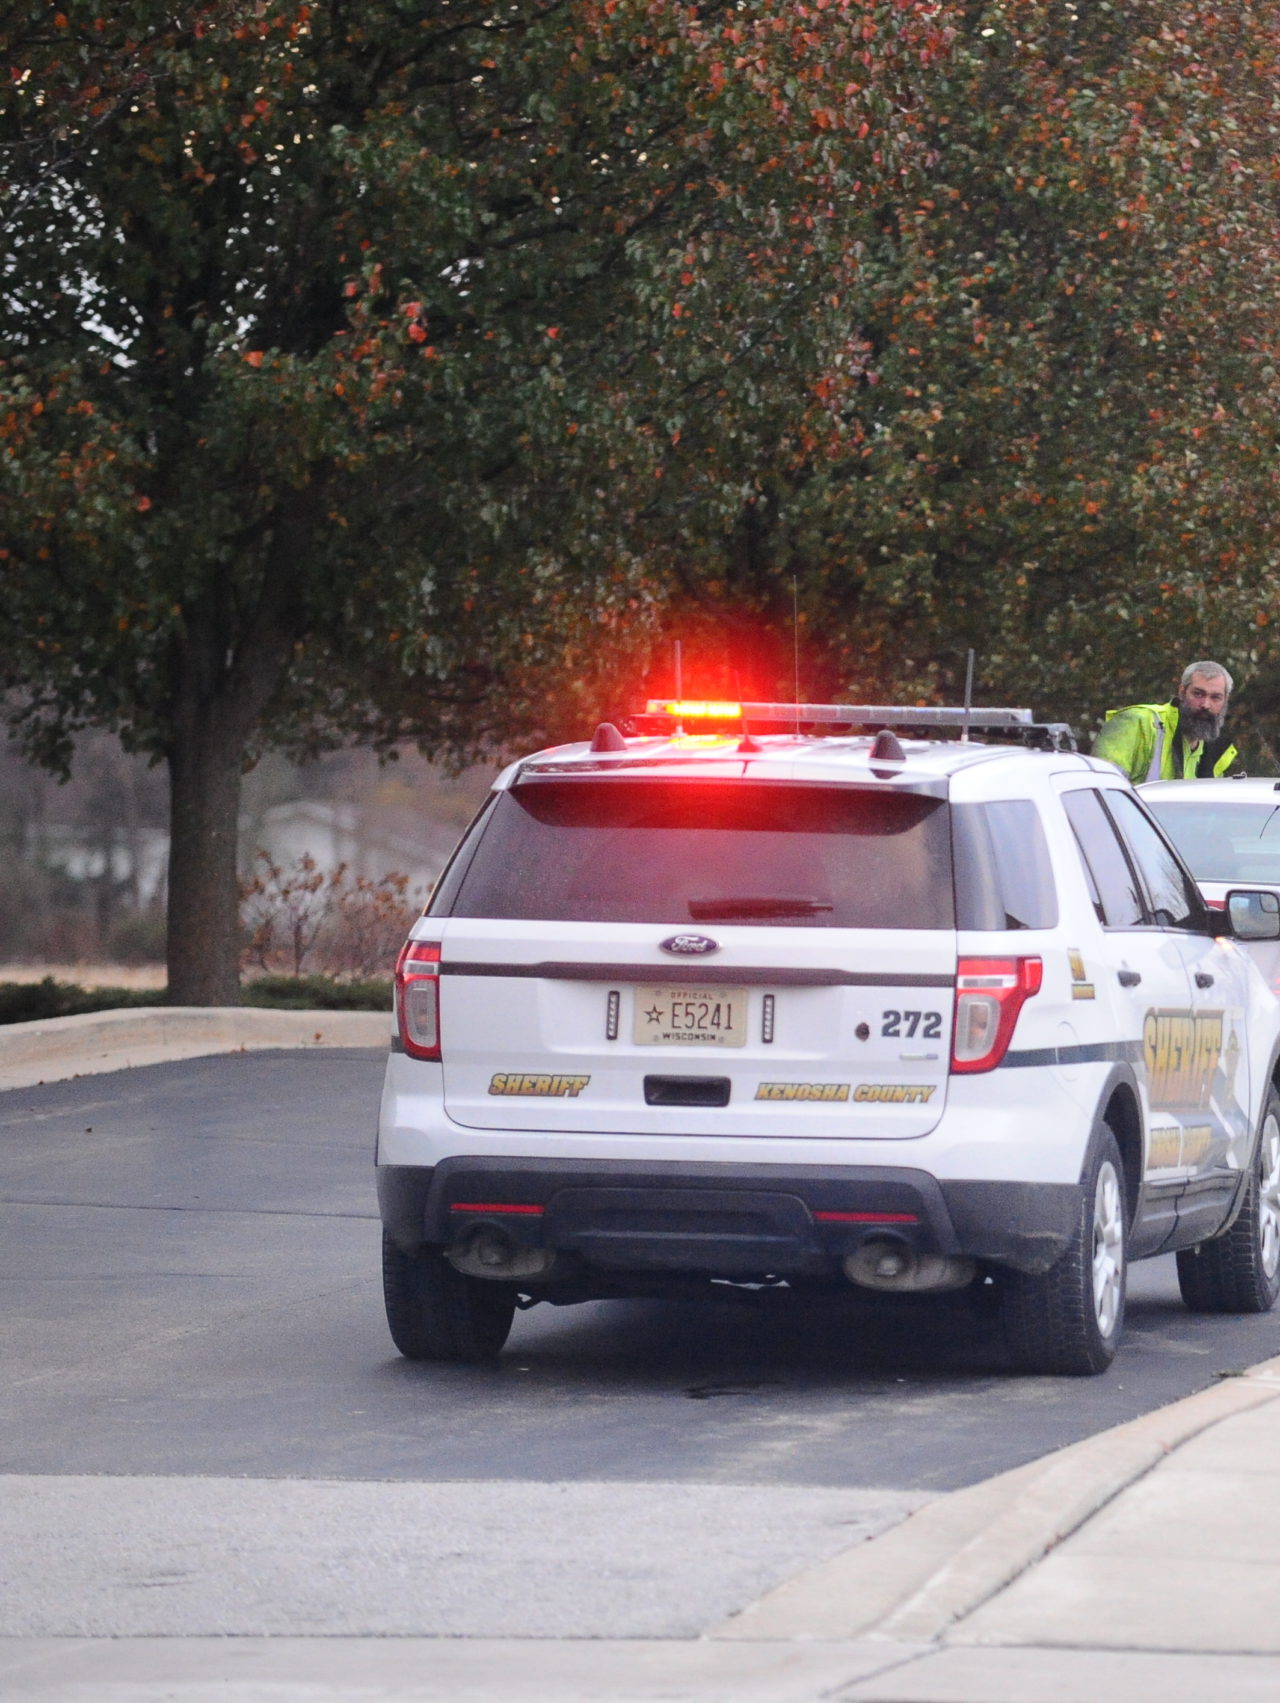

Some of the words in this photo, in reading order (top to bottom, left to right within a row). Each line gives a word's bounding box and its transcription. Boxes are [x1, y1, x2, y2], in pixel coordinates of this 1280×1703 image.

[671, 936, 708, 952] Ford
[671, 991, 713, 1000] OFFICIAL
[672, 1002, 732, 1030] E5241
[881, 1010, 942, 1039] 272
[662, 1032, 716, 1041] WISCONSIN
[488, 1072, 591, 1098] SHERIFF
[754, 1082, 850, 1102] KENOSHA
[853, 1084, 937, 1104] COUNTY
